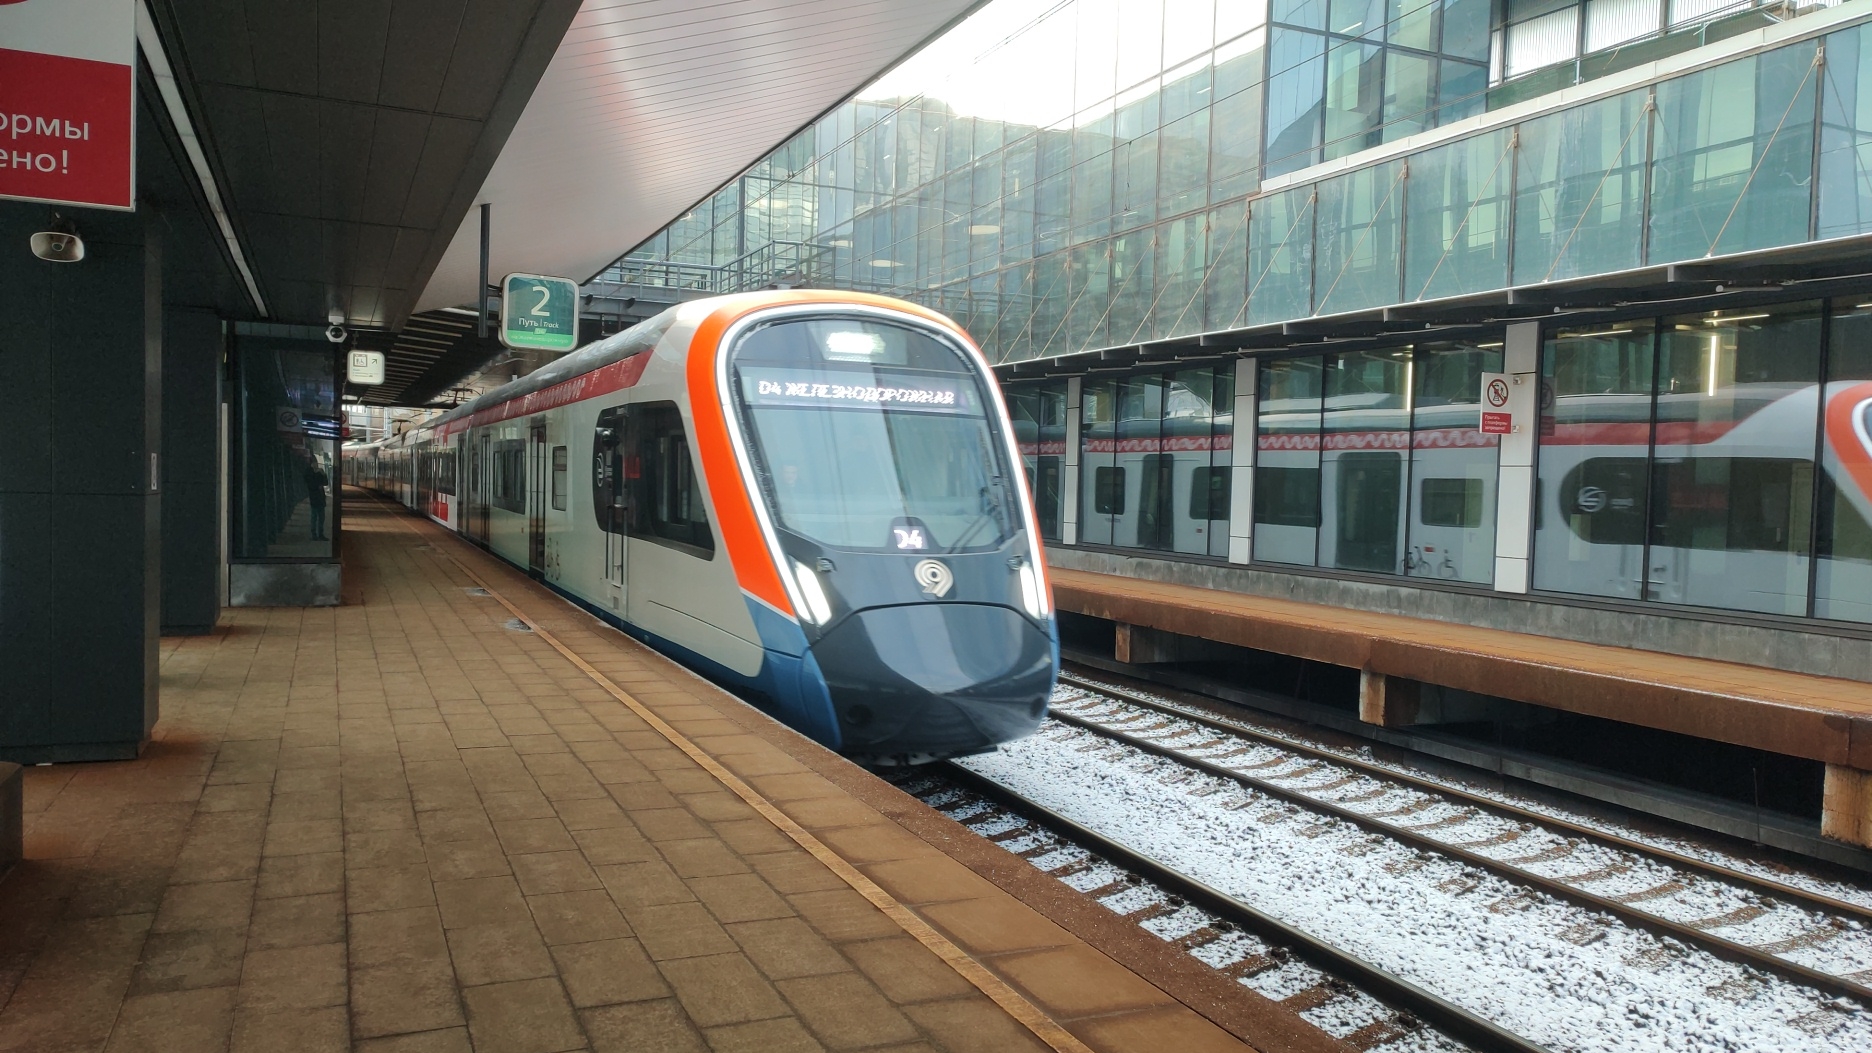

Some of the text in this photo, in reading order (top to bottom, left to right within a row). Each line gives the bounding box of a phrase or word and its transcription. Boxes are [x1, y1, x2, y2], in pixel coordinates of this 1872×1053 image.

[531, 285, 550, 316] 2
[518, 317, 539, 328] Путь
[543, 321, 560, 329] Track
[758, 381, 781, 395] D4
